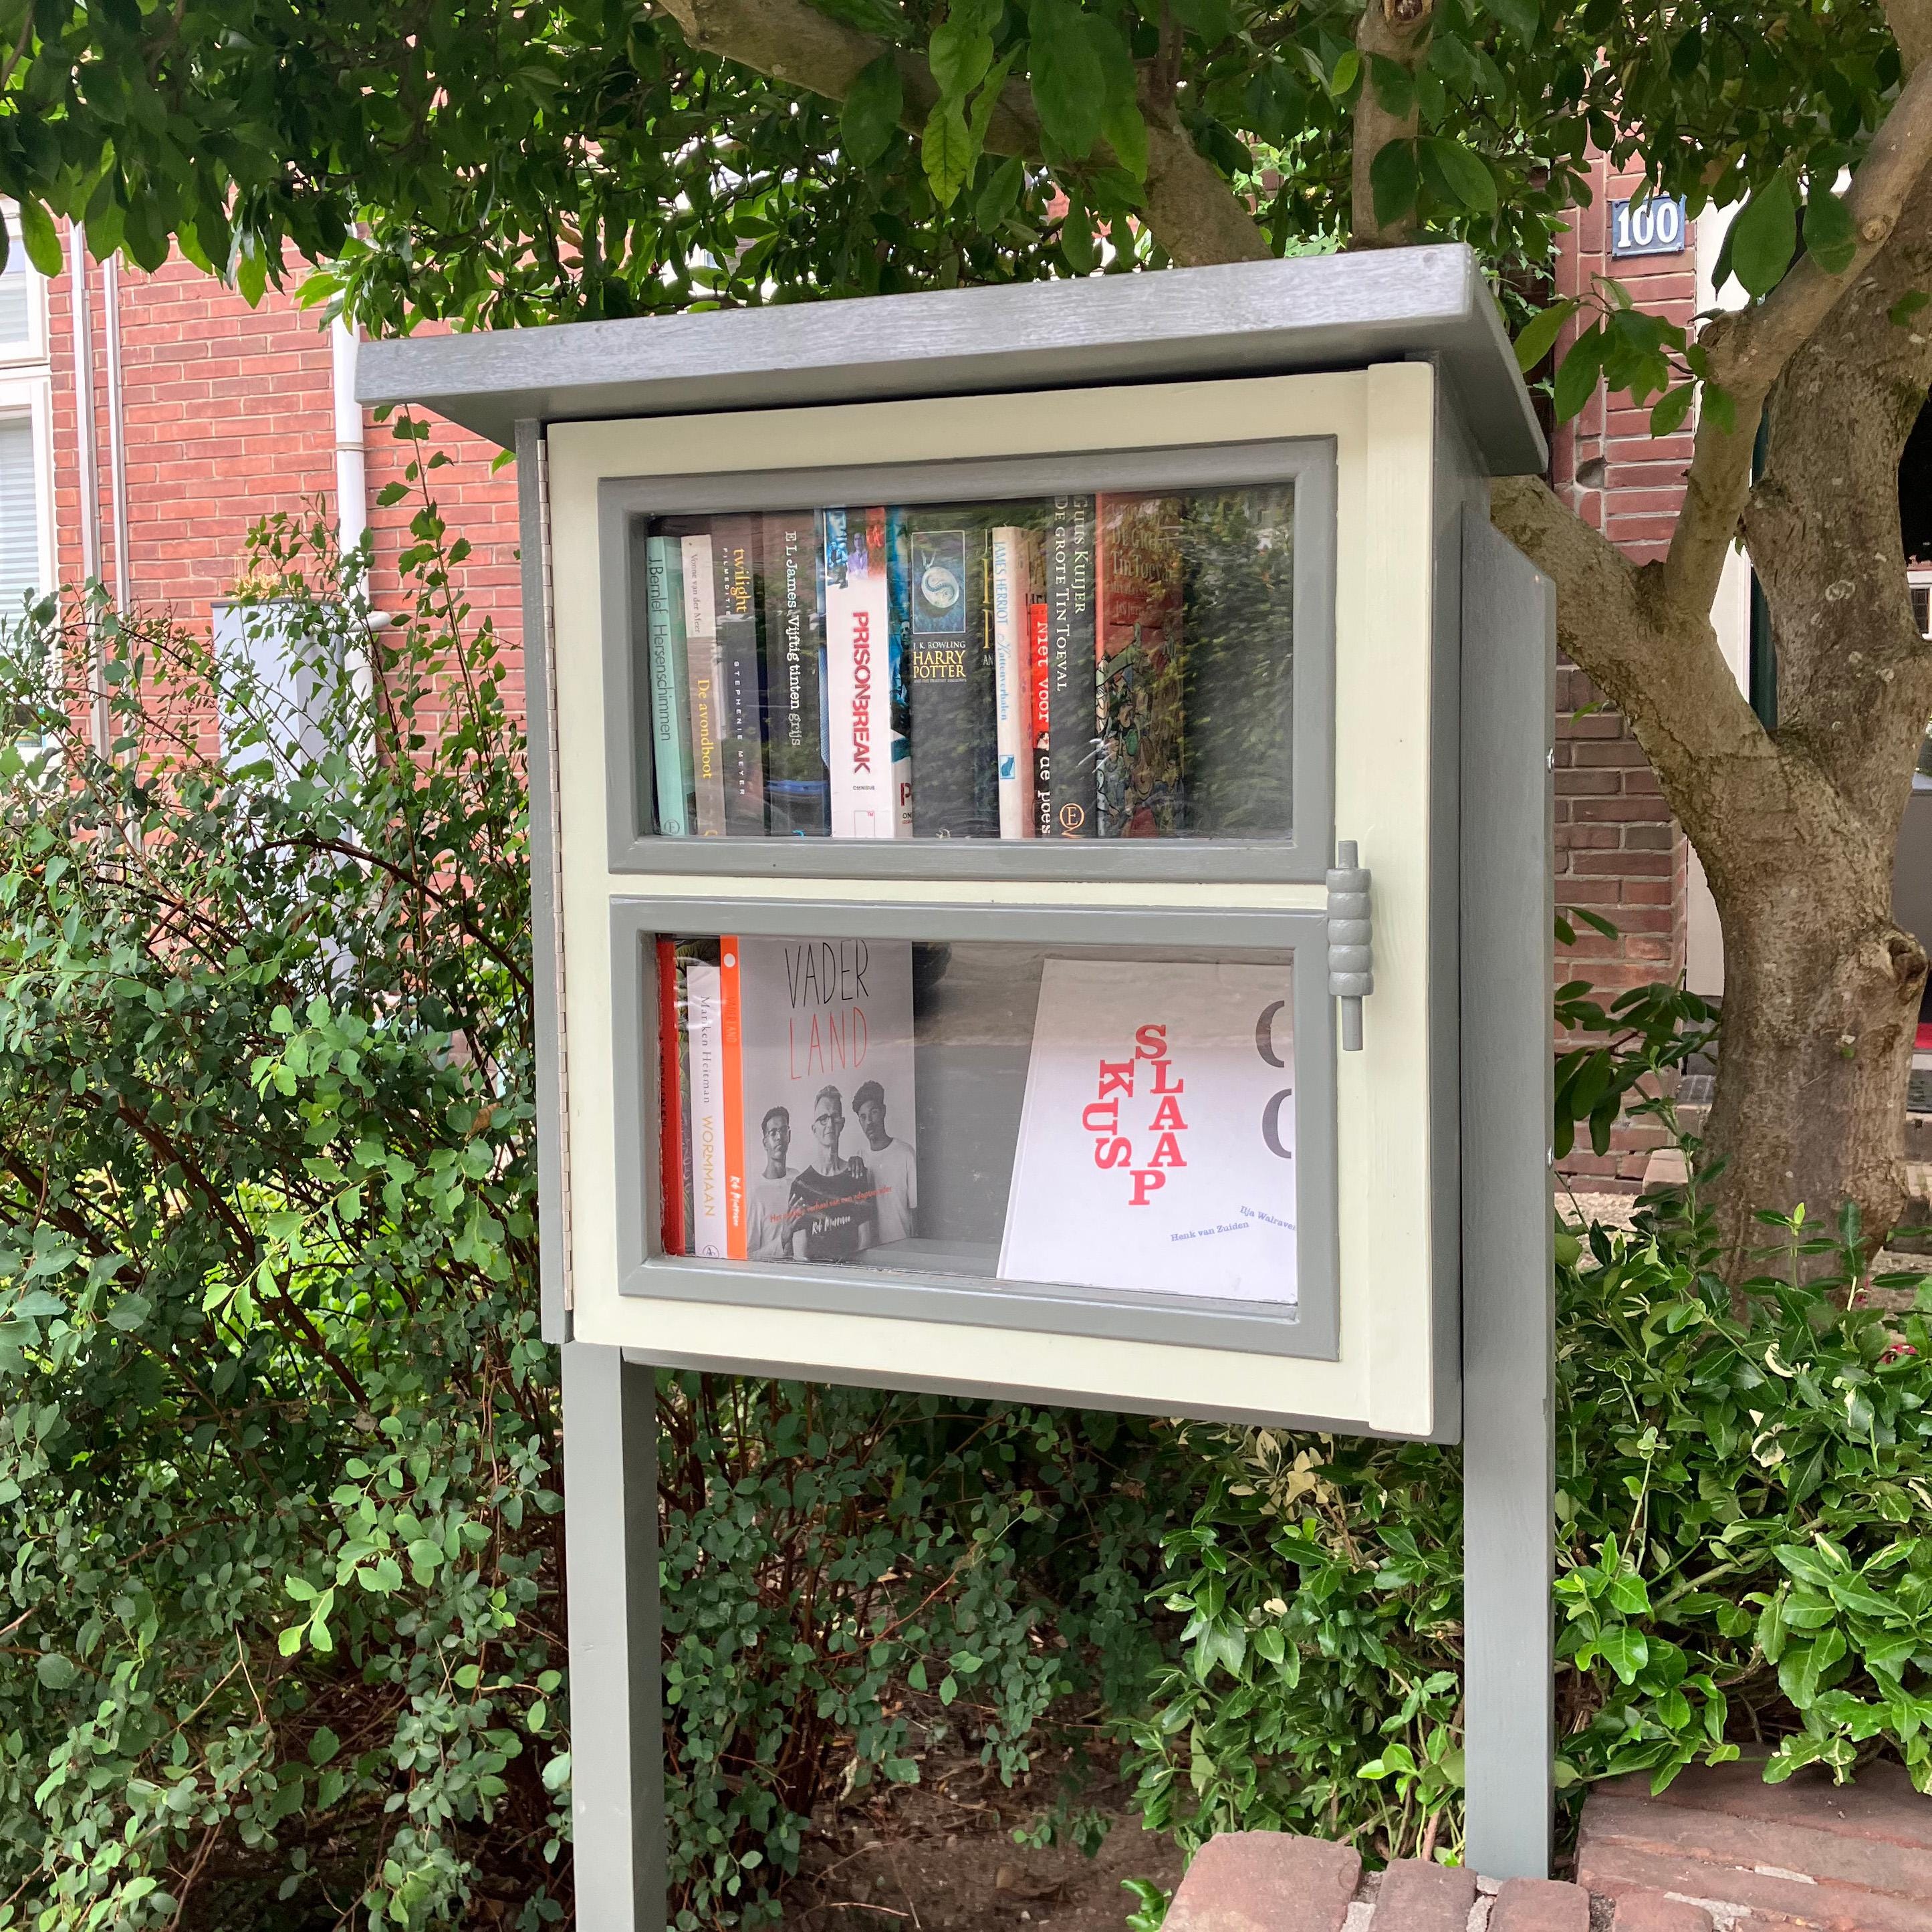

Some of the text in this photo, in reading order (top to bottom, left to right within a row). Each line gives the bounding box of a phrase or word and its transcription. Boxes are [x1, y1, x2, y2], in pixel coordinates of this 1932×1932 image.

[1617, 202, 1679, 248] 100
[690, 554, 698, 578] Vonne
[723, 548, 731, 616] FILMEDITIE
[730, 548, 751, 612] twilight
[693, 597, 701, 610] der
[693, 612, 701, 634] Meer
[994, 541, 1011, 720] JAMES HERRIOT Kattenverhalen
[785, 531, 802, 746] E L James Vijftig tinten grijs
[913, 650, 966, 665] HARRY
[928, 641, 966, 649] ROWLING
[652, 624, 675, 741] Hersenschimmen
[734, 660, 743, 740] STEPHENIE
[852, 612, 871, 774] PRISONBREAK
[913, 665, 967, 679] POTTER
[1038, 677, 1049, 722] voor
[697, 679, 714, 779] De avondboot
[1038, 790, 1051, 835] poes
[784, 938, 869, 1009] VADER
[790, 1006, 868, 1080] LAND
[703, 1052, 712, 1104] Heitman
[1082, 1058, 1135, 1170] KUS
[1128, 1024, 1188, 1205] SLAAP
[701, 1115, 716, 1217] WORMMAAN
[1171, 1221, 1249, 1242] Henk van Zuiden
